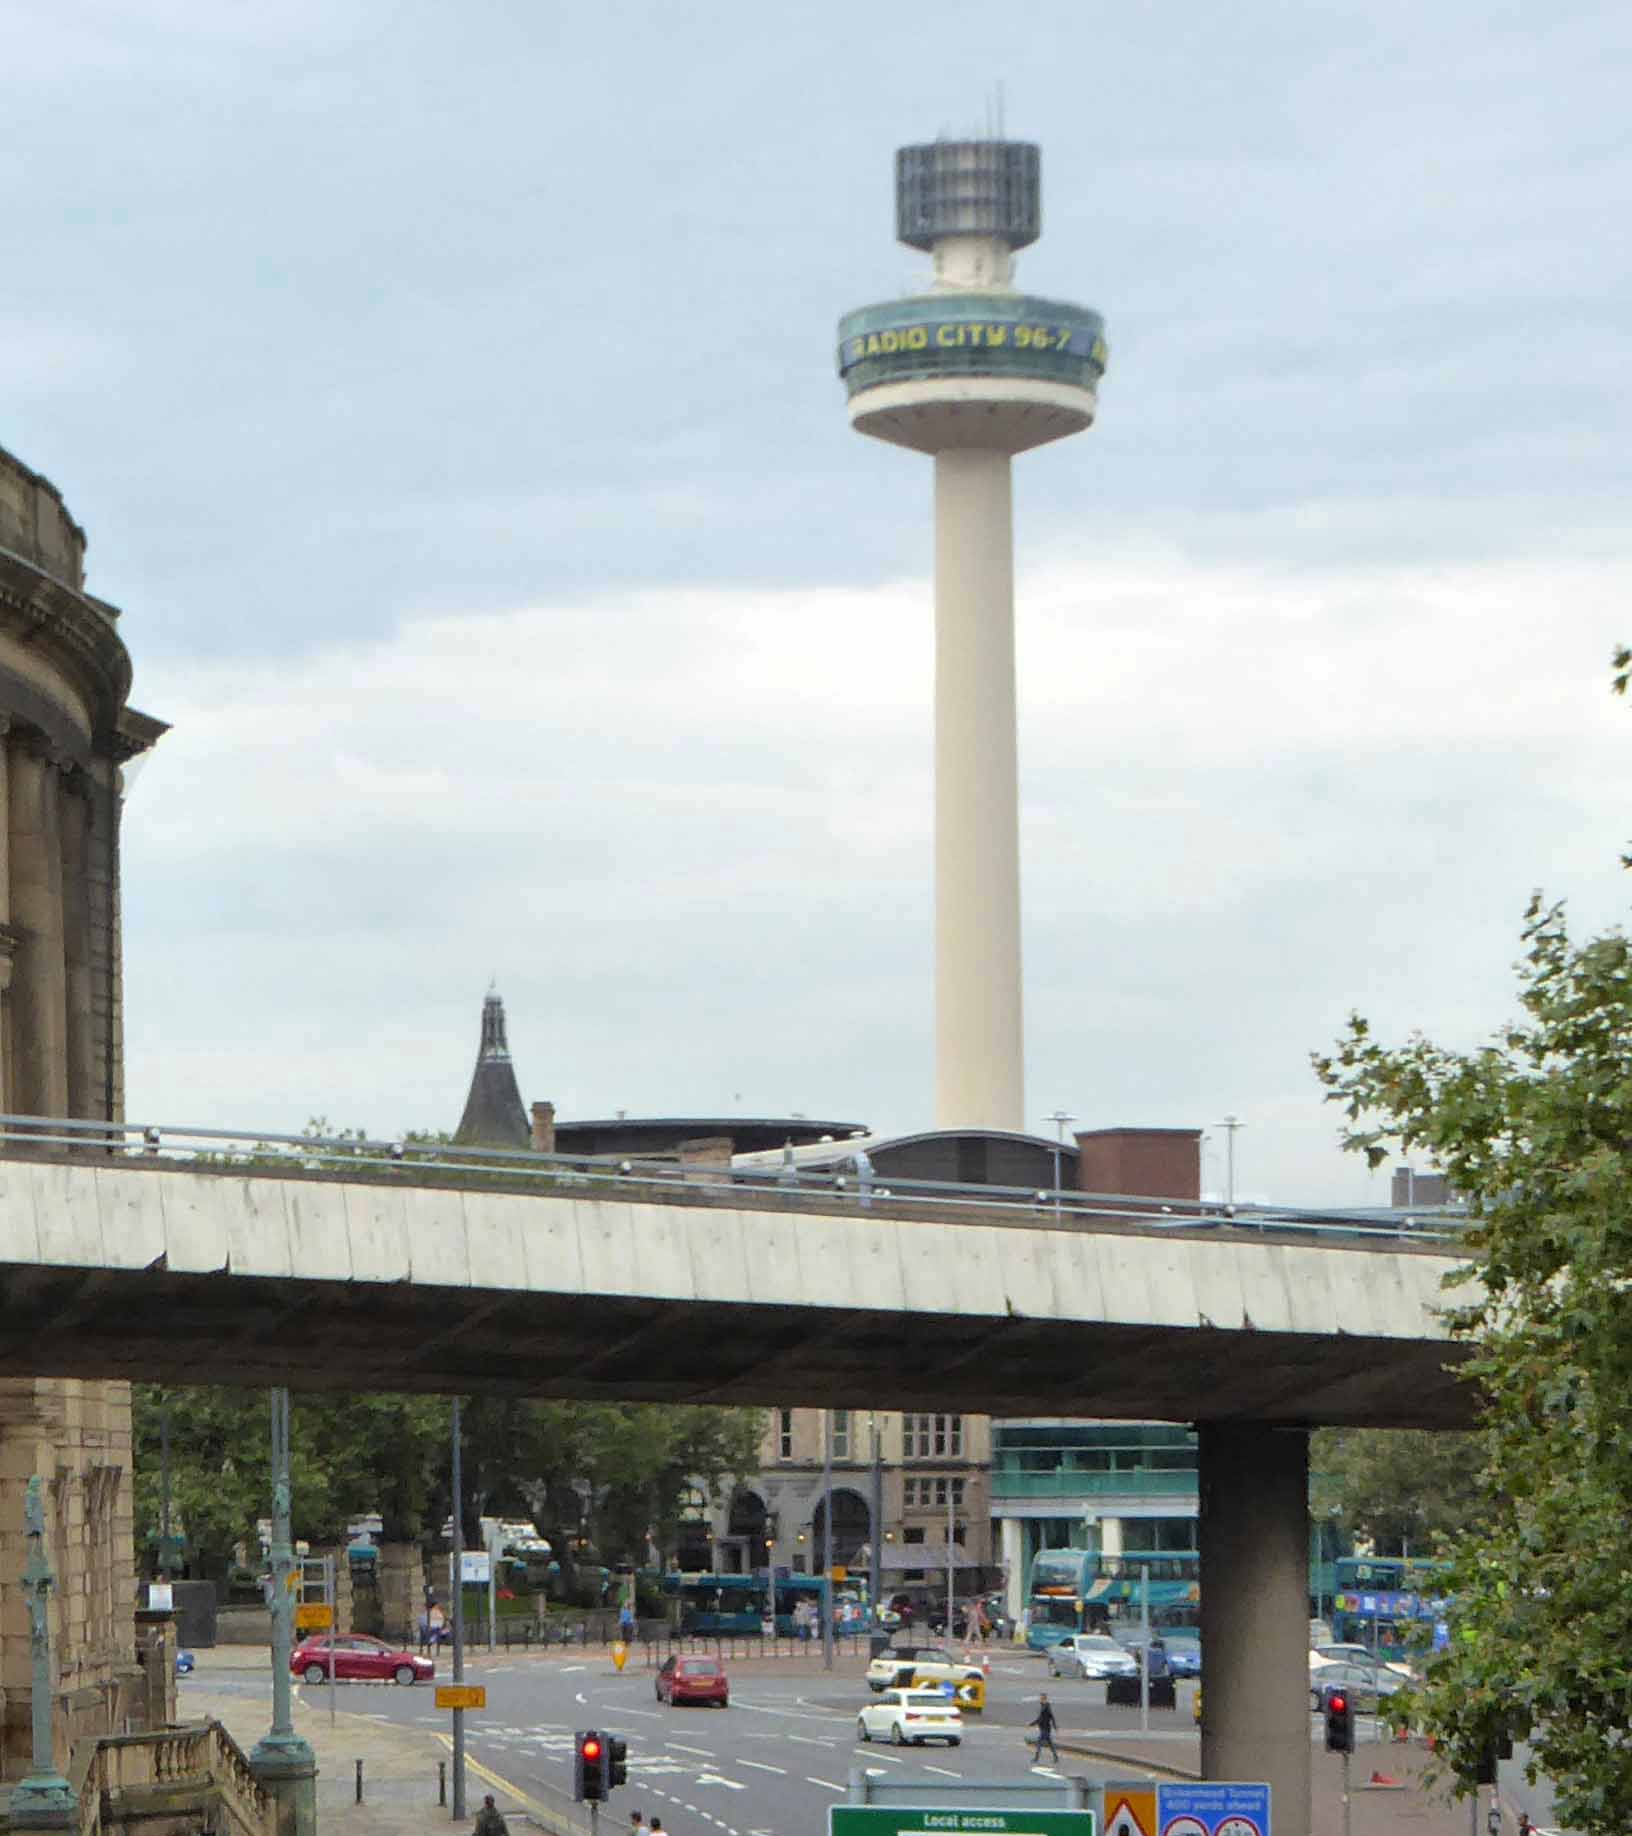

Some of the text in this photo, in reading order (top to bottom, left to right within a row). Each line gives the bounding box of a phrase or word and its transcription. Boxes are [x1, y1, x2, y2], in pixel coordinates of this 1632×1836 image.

[937, 324, 1006, 346] CITY
[924, 1814, 1006, 1828] Local access
